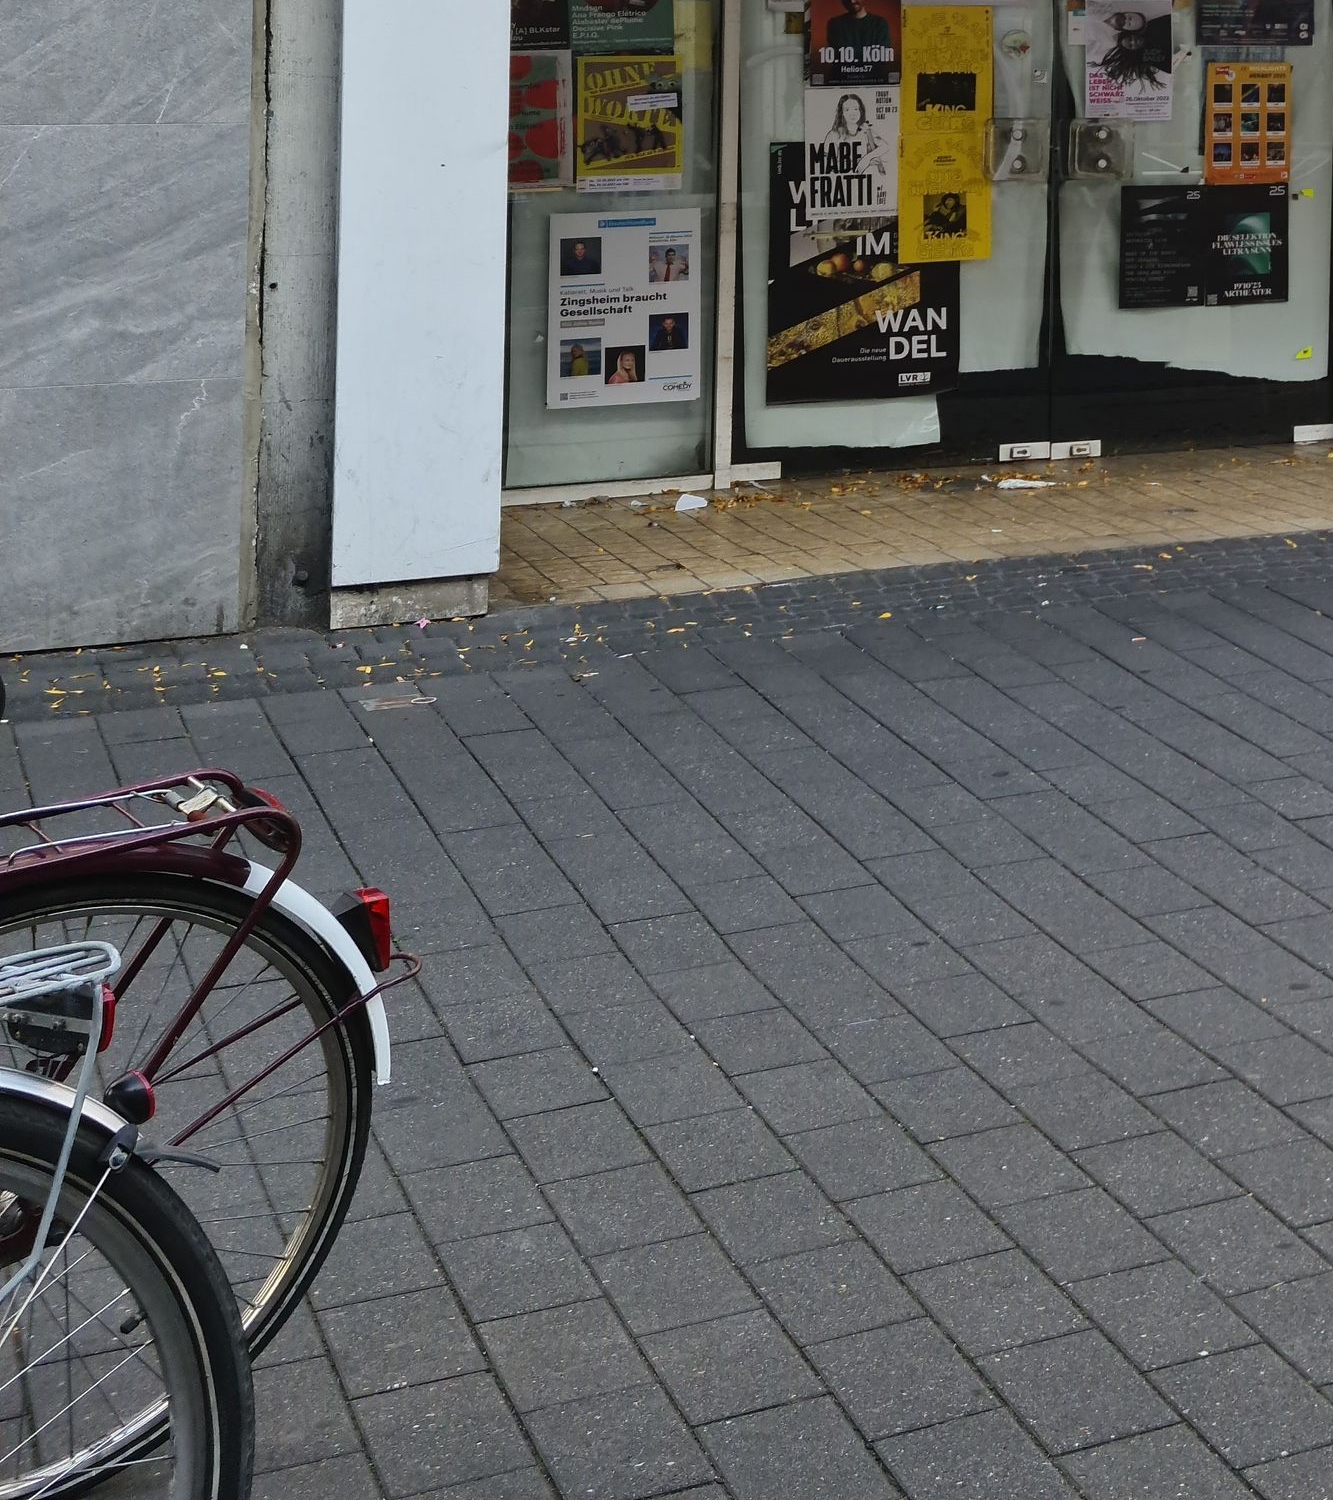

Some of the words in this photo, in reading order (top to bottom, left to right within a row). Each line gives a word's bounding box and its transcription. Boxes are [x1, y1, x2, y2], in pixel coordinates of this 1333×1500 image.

[819, 46, 858, 63] 10.10.
[862, 44, 895, 63] Köln
[585, 61, 657, 91] OHNE
[841, 64, 873, 74] Helios37
[810, 141, 862, 175] MABE
[810, 174, 873, 209] FRATTI
[857, 231, 891, 256] IM
[560, 296, 621, 309] Zingsheim
[622, 292, 668, 304] braucht
[560, 304, 633, 318] Gesellschaft
[875, 306, 948, 334] WAN
[889, 334, 948, 361] DEL
[831, 354, 888, 364] Dauerausstellung
[662, 382, 692, 393] COMEDY
[900, 373, 920, 383] LVR
